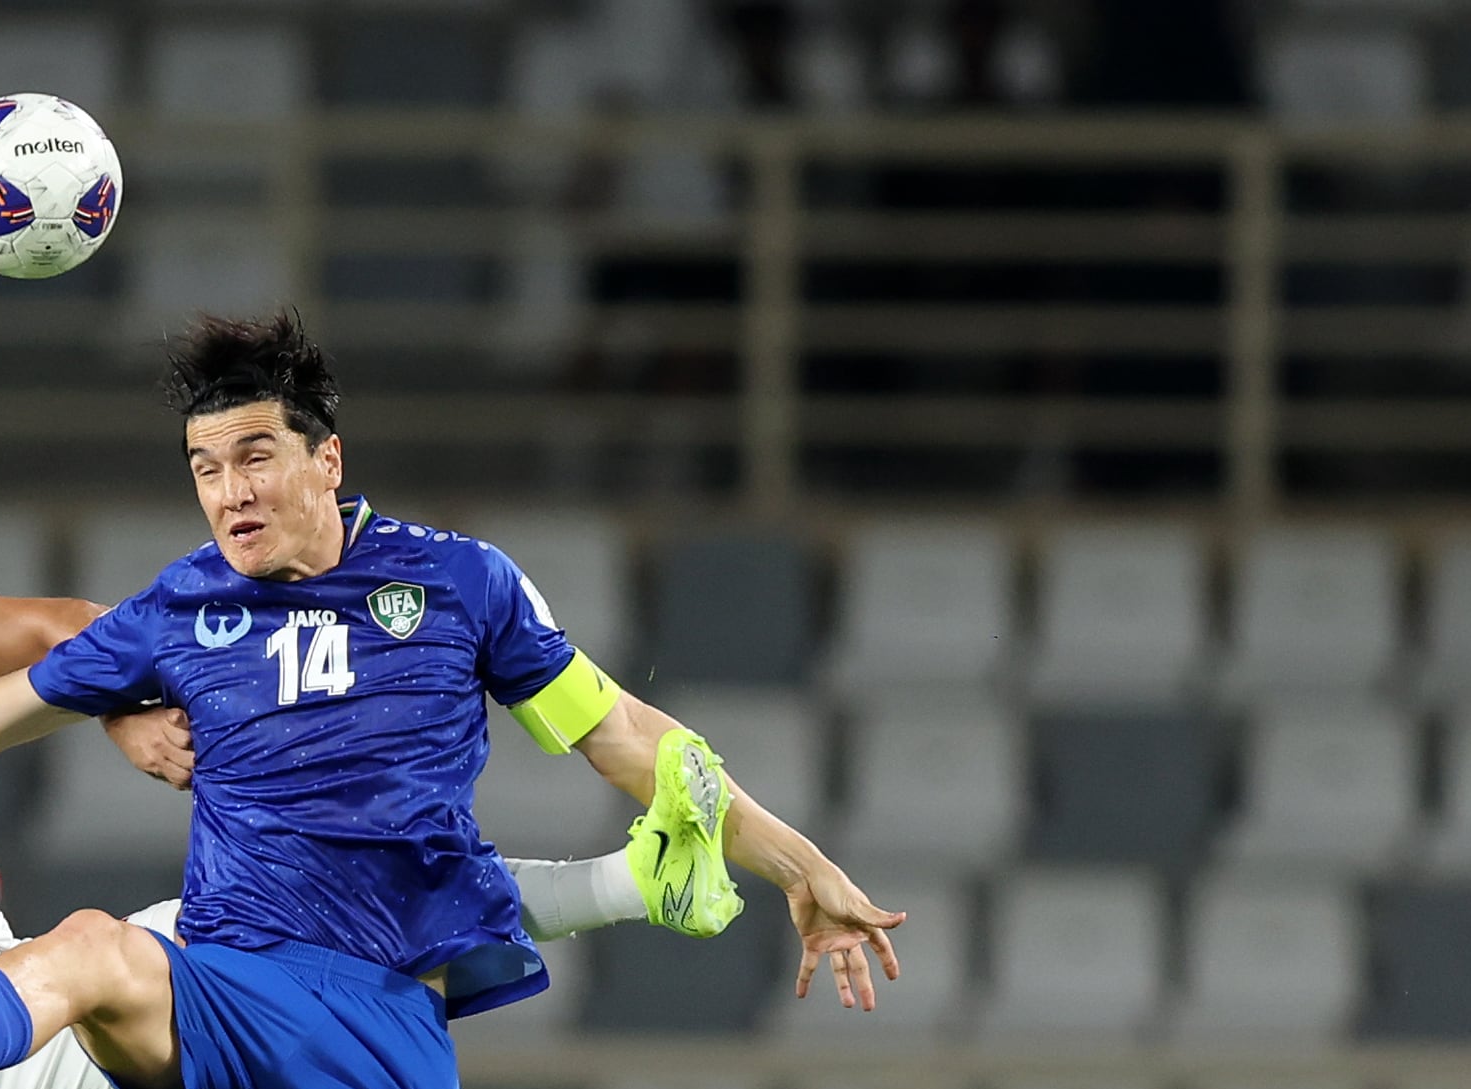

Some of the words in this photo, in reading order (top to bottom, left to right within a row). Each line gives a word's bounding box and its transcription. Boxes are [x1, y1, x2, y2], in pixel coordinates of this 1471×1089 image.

[14, 138, 84, 157] molten
[377, 591, 418, 615] UFA
[285, 609, 337, 627] JAKO
[266, 624, 355, 706] 14
